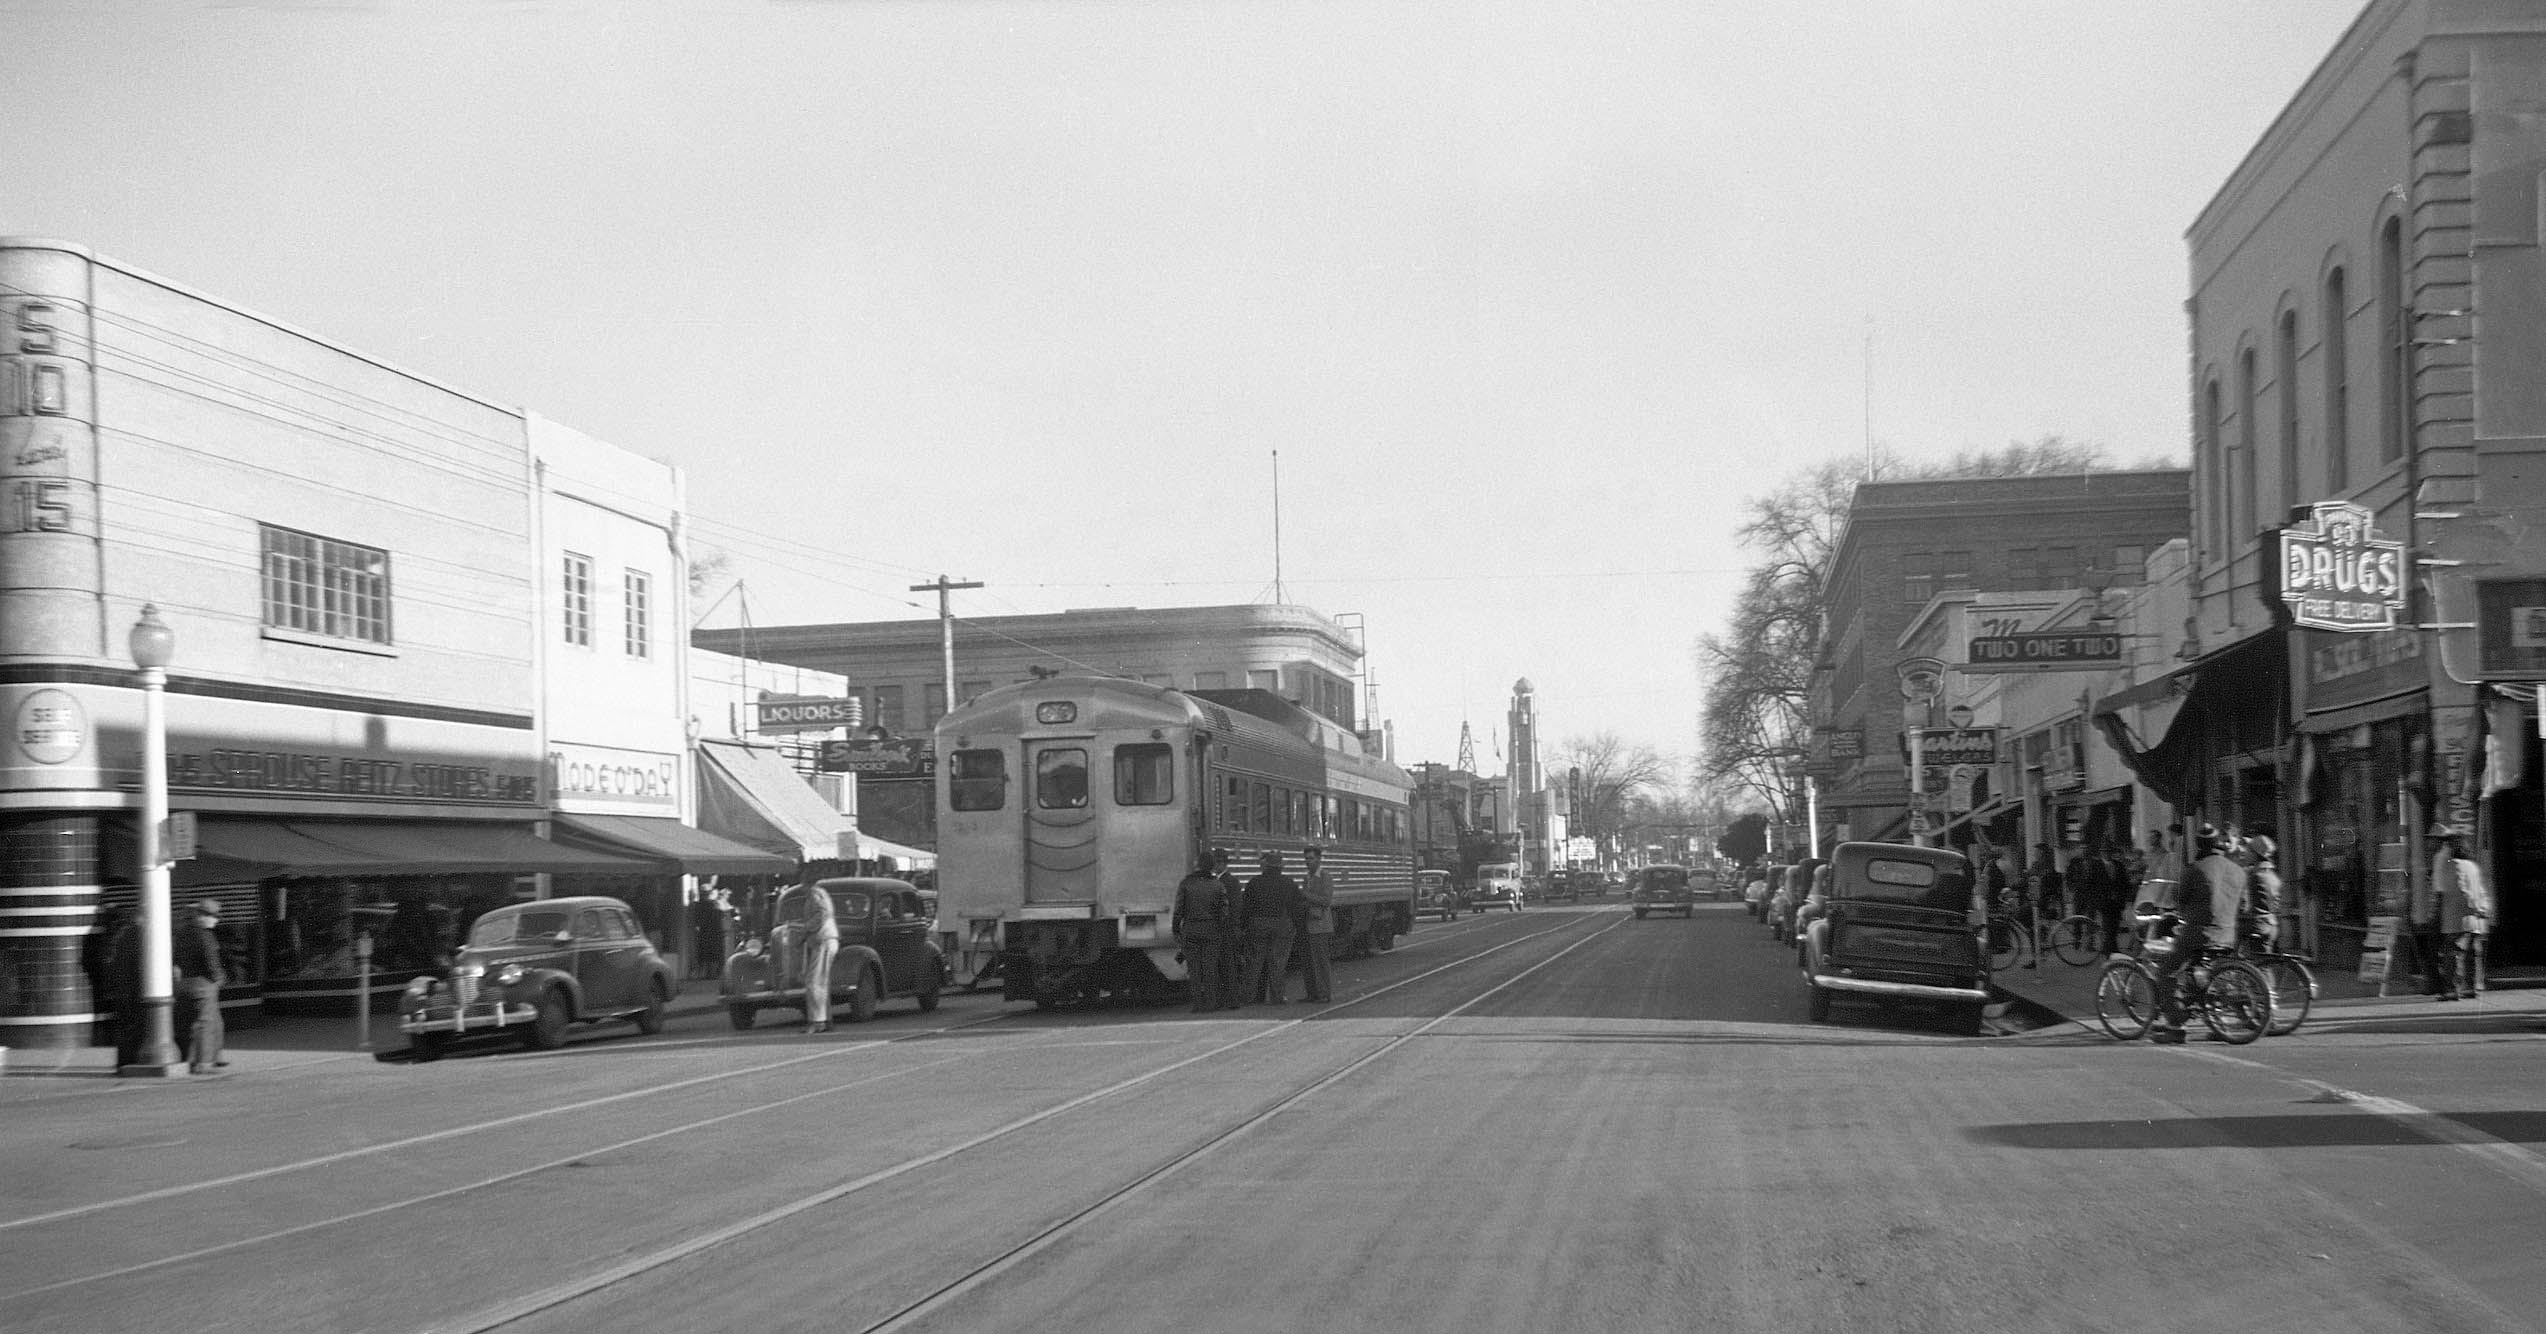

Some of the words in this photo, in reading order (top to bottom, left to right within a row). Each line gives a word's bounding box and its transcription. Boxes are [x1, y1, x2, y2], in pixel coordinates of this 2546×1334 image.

[17, 302, 55, 356] 5
[2289, 544, 2398, 597] DRUGS
[2304, 598, 2333, 618] FREE
[1973, 640, 2019, 658] TWO
[2024, 639, 2067, 657] ONE
[2071, 636, 2118, 655] TWO
[760, 704, 843, 722] LIQUORS
[211, 748, 331, 791] SPROUSE
[412, 762, 488, 798] STORES
[547, 751, 609, 793] MODE
[614, 761, 672, 797] O'DAY
